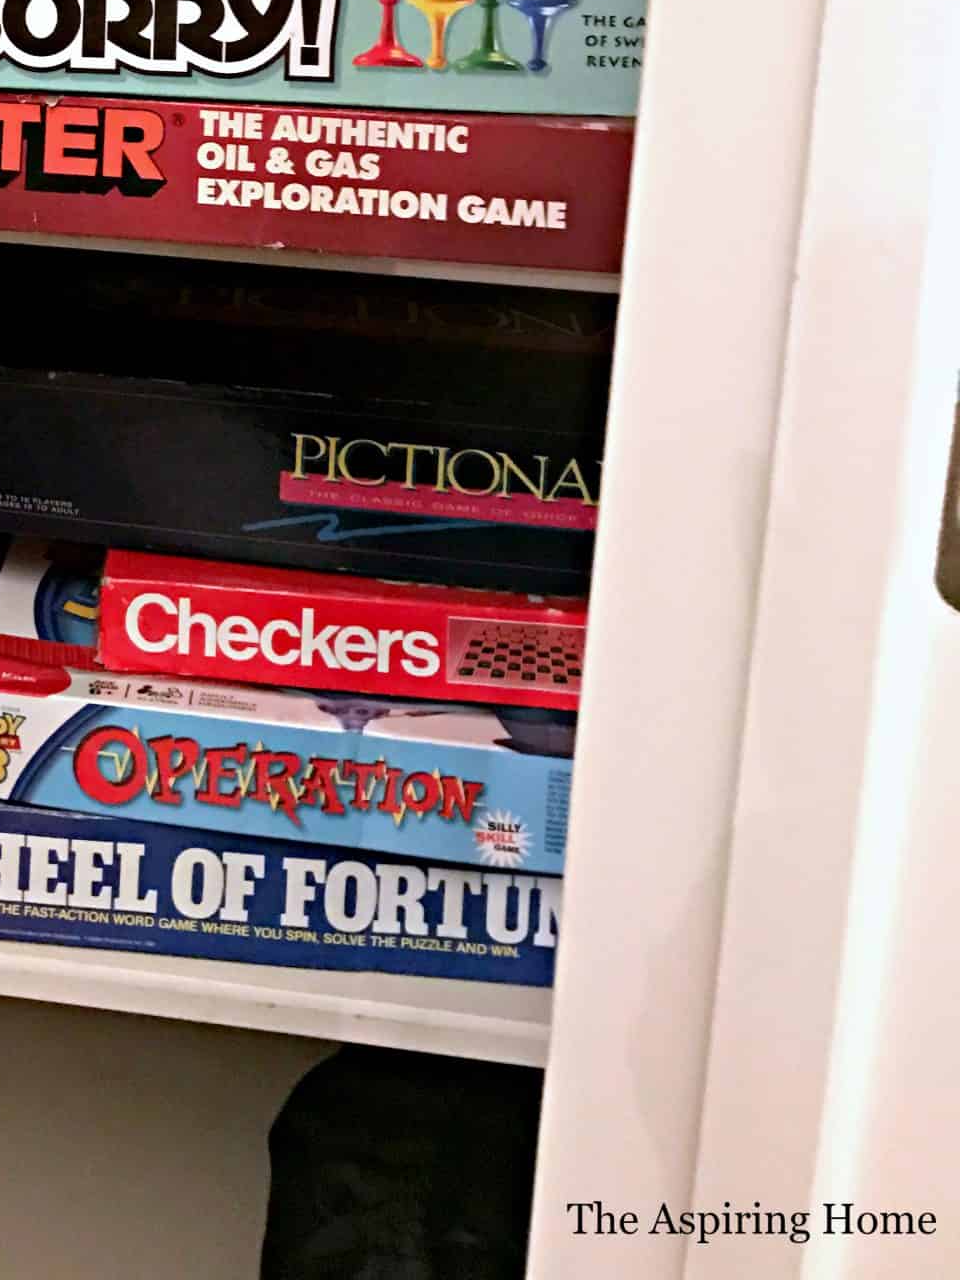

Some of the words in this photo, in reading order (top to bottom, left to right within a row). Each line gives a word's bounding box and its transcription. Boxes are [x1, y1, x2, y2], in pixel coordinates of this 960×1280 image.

[582, 14, 617, 28] THE
[585, 35, 611, 48] OF
[614, 36, 644, 48] SW
[198, 110, 263, 141] THE
[270, 114, 470, 154] AUTHENTIC
[196, 143, 256, 173] OIL
[264, 146, 297, 177] &
[305, 151, 381, 181] GAS
[196, 178, 449, 222] EXPLORATION
[457, 196, 568, 230] GAME
[290, 431, 602, 507] PICTIONA
[308, 489, 339, 502] THE
[349, 493, 423, 511] CLASSIC
[431, 501, 481, 514] GAME
[124, 591, 440, 678] Checkers
[74, 724, 485, 826] OPERATION
[474, 831, 515, 844] SKILL
[493, 844, 521, 855] GAME
[171, 846, 266, 922] OF
[23, 906, 113, 925] FAST-ACTION
[112, 912, 155, 929] WORD
[158, 917, 200, 933] GAME
[201, 920, 250, 937] WHERE
[253, 925, 284, 941] YOU
[286, 929, 320, 945] SPIN,
[323, 932, 367, 948] SOLVE
[370, 935, 397, 949] THE
[400, 937, 453, 953] PUZZLE
[456, 942, 488, 956] AND
